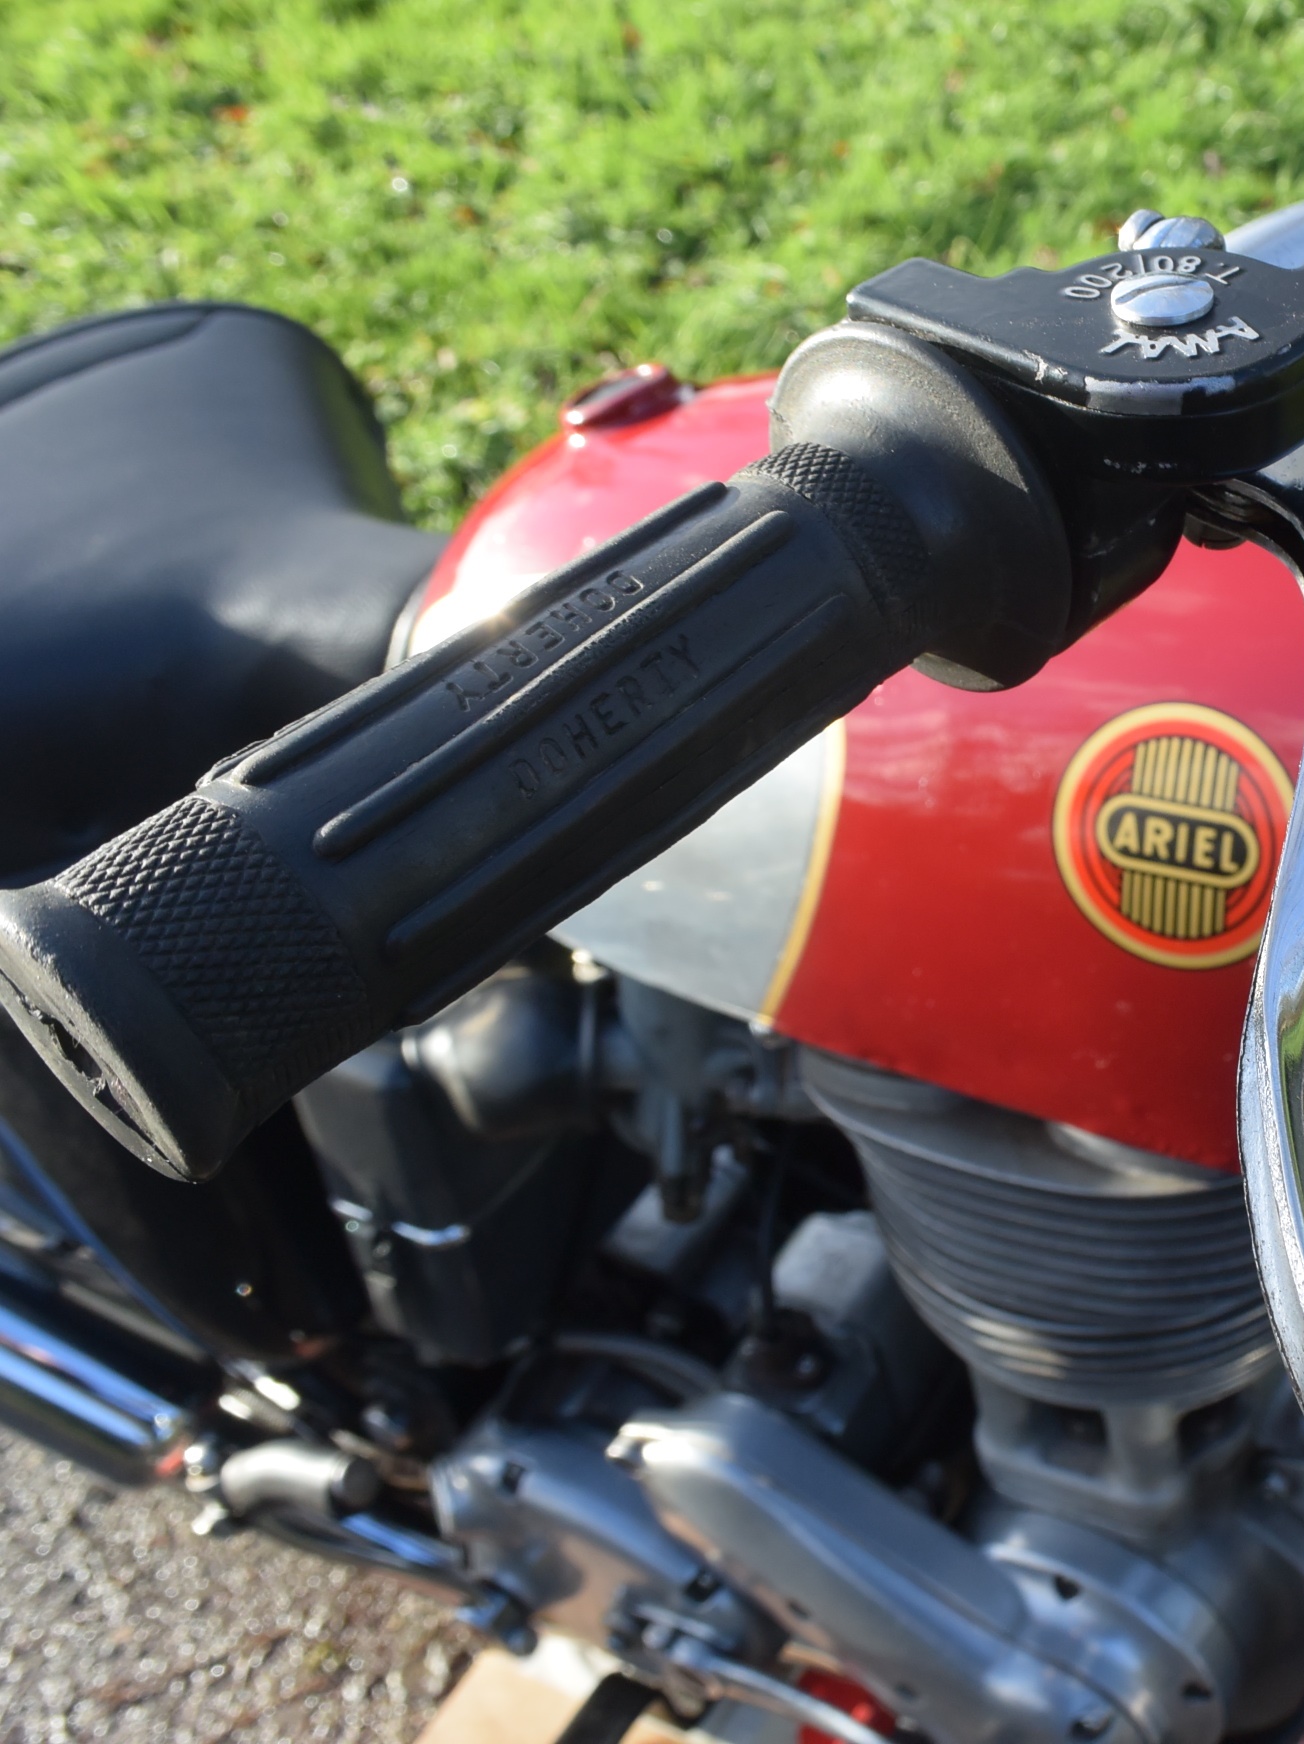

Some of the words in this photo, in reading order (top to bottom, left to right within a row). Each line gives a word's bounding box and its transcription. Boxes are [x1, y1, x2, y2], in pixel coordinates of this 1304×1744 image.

[1100, 315, 1260, 360] AMAL
[445, 569, 645, 713] DOHERTY
[507, 632, 700, 800] DOHERTY
[1112, 811, 1240, 874] ARIEL
